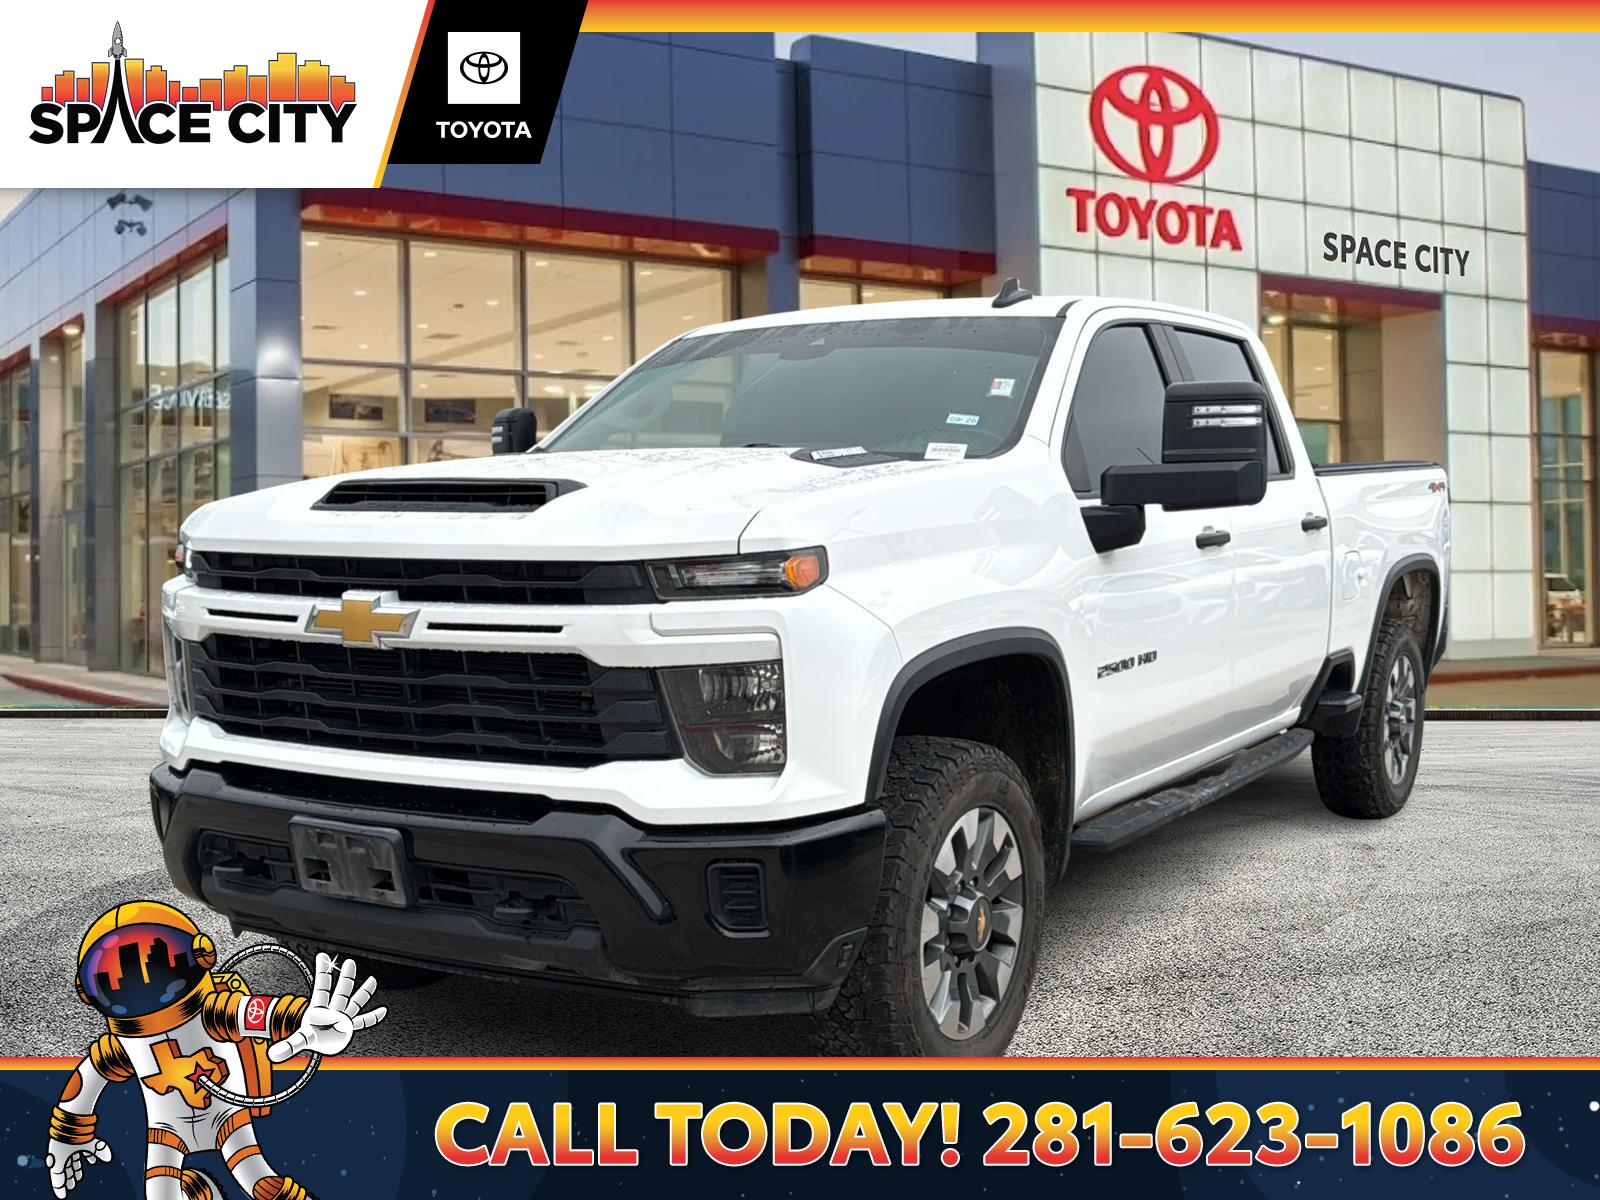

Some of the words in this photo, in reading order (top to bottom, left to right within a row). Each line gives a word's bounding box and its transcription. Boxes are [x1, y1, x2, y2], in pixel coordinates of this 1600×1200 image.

[1065, 187, 1242, 251] TOYOTA
[1323, 232, 1407, 271] SPACE
[1415, 245, 1471, 277] CITY
[1097, 656, 1135, 679] 2500
[1137, 650, 1157, 666] HD
